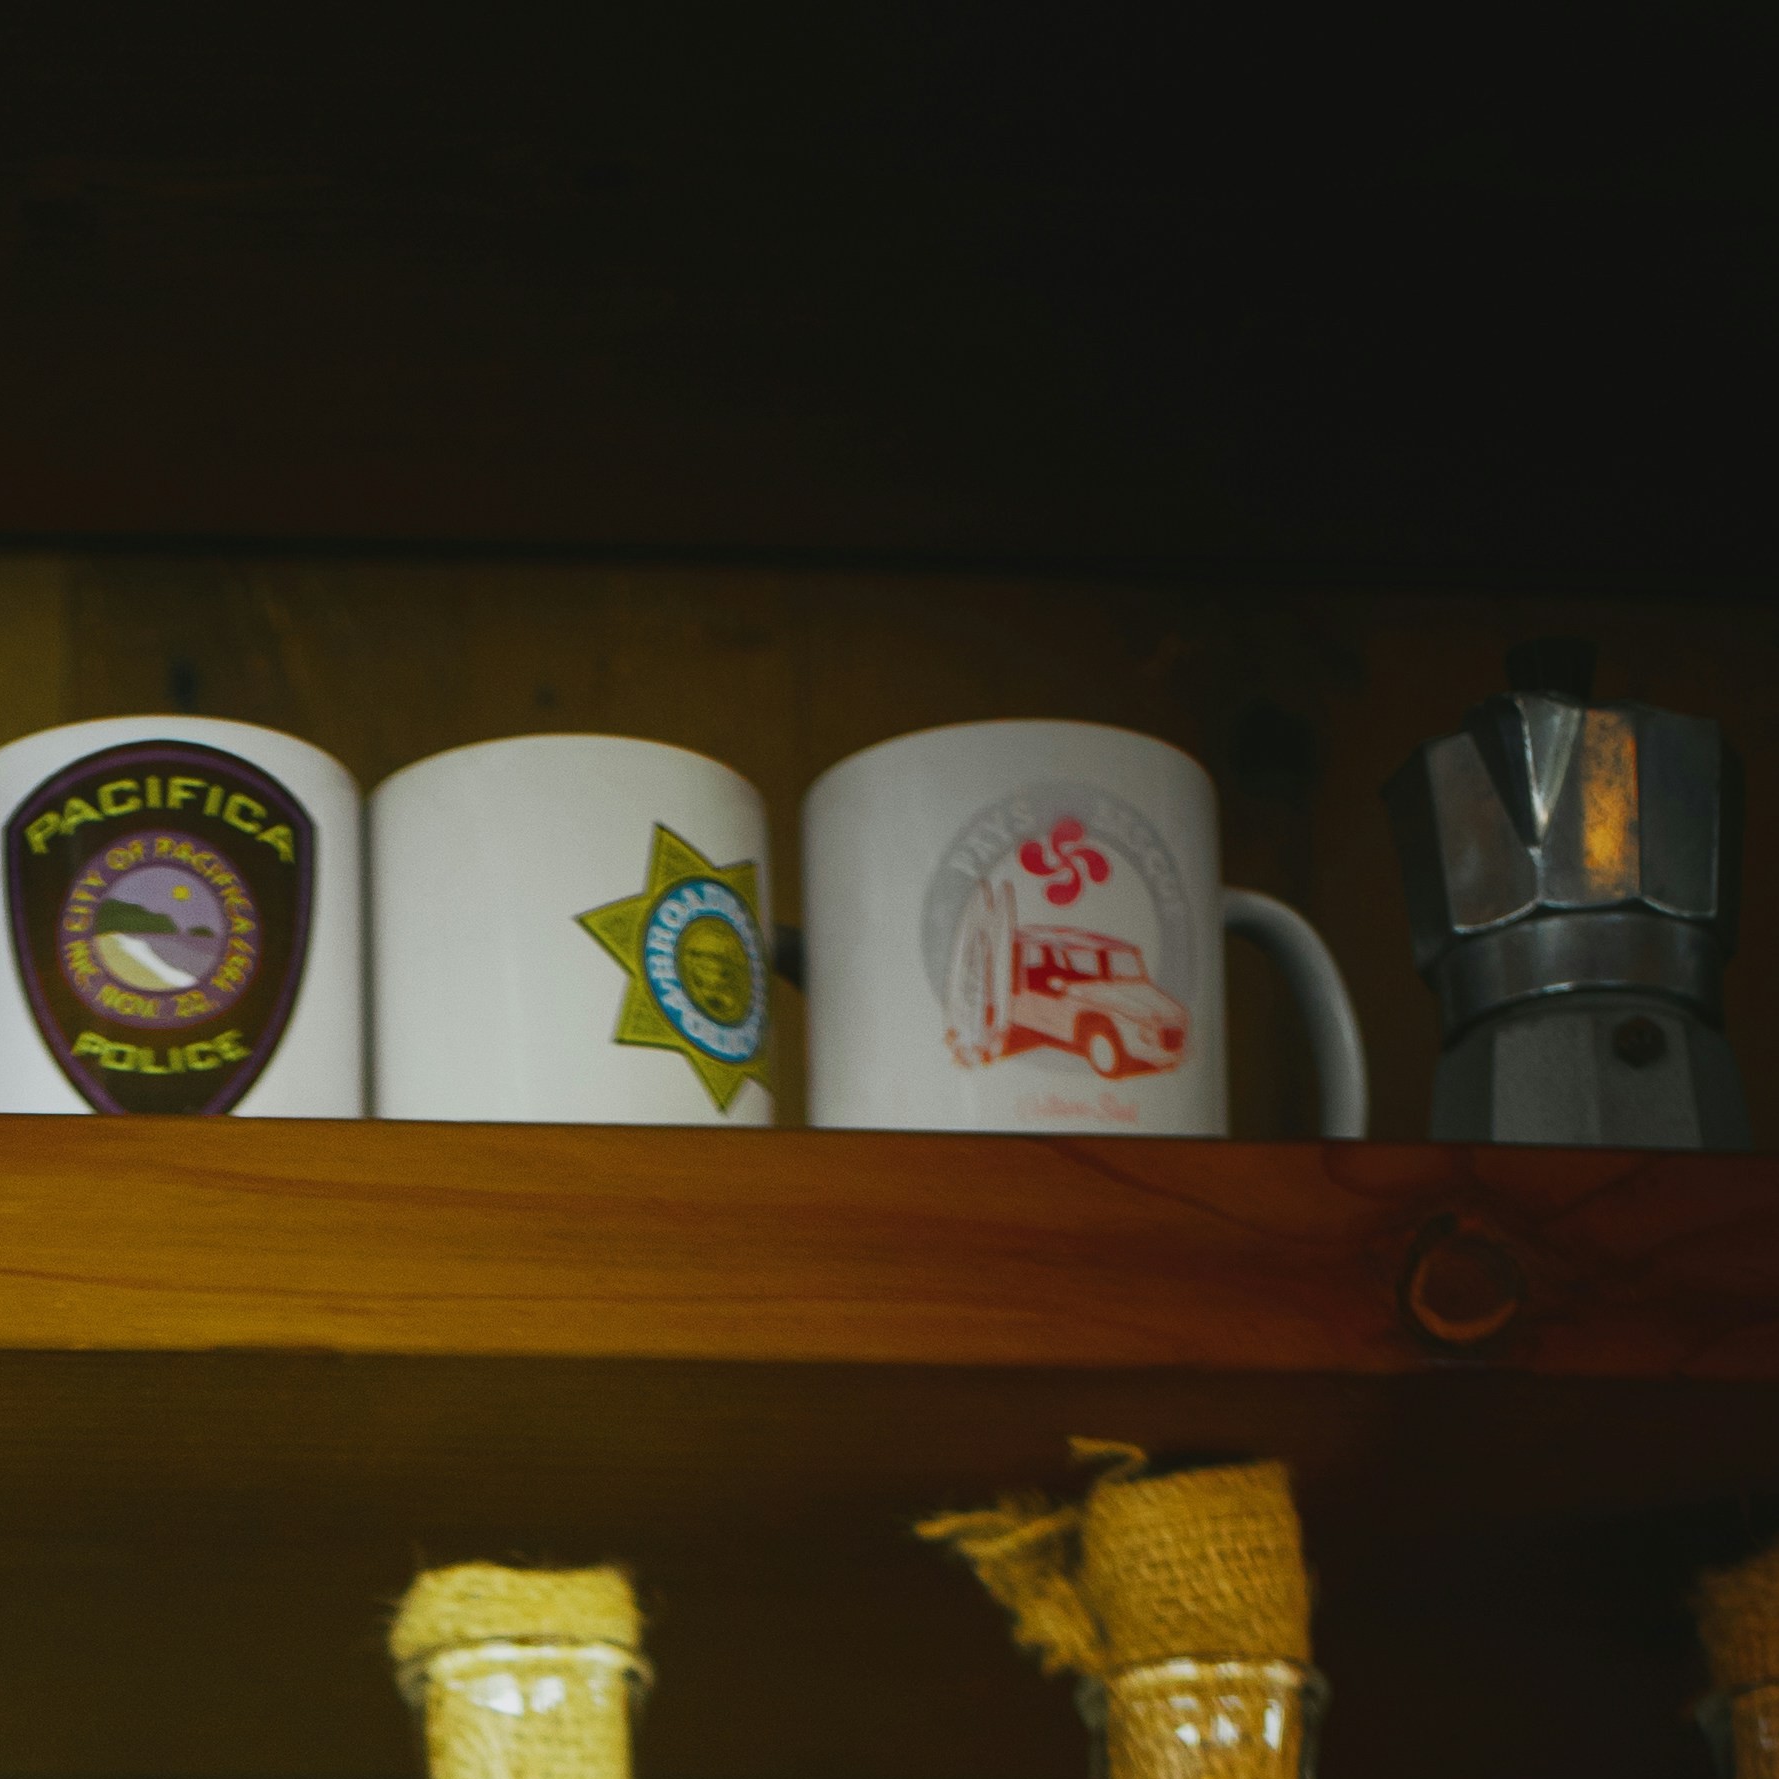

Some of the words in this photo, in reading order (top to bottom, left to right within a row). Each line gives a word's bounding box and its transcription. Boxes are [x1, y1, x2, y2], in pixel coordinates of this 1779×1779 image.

[24, 775, 296, 863] PACIFICA
[63, 868, 108, 932] CITY
[105, 838, 145, 872] OF
[153, 835, 256, 934] PACIFICA
[71, 1028, 253, 1075] POLICE
